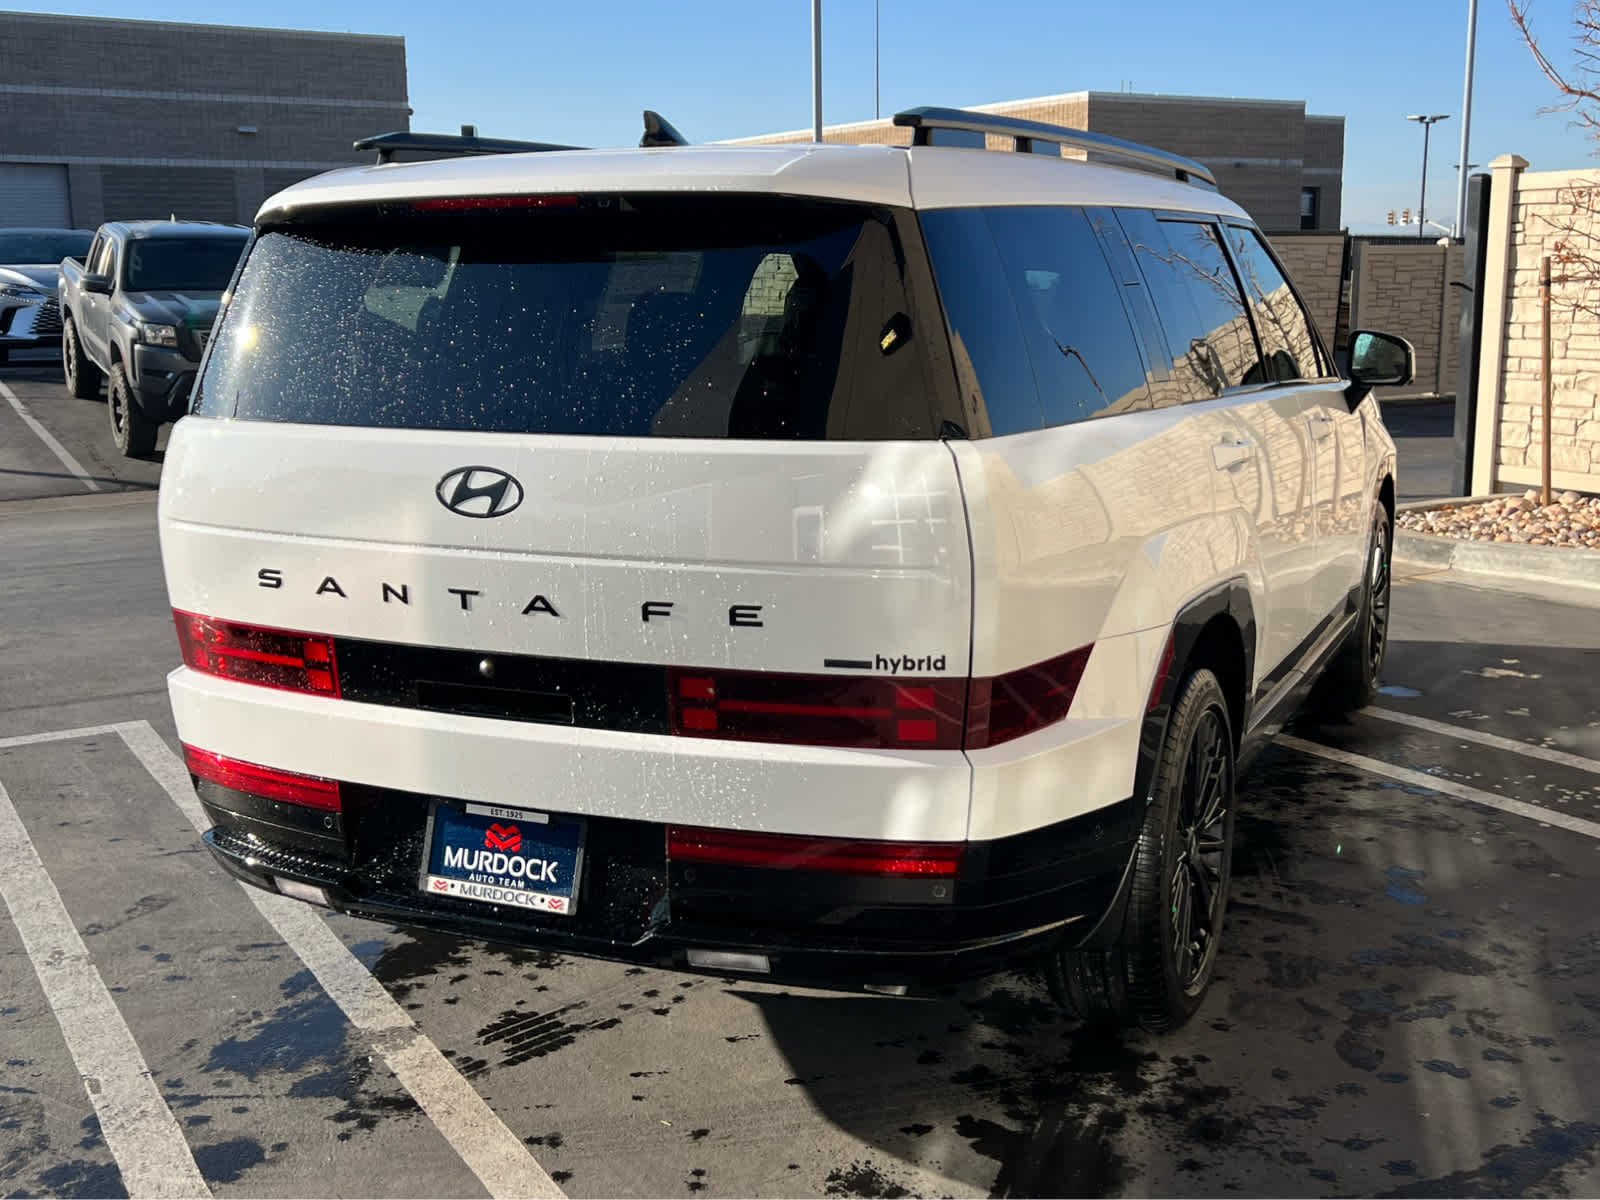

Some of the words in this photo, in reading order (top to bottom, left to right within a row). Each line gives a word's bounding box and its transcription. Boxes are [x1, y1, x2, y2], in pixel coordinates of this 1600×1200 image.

[257, 568, 561, 617] SANTA
[641, 601, 764, 627] FE
[875, 654, 946, 674] hybrid
[506, 811, 524, 819] 1925
[444, 845, 559, 883] MURDOCK
[469, 873, 495, 884] AUTO
[499, 878, 525, 889] TEAM
[459, 884, 537, 906] MURDOCK
